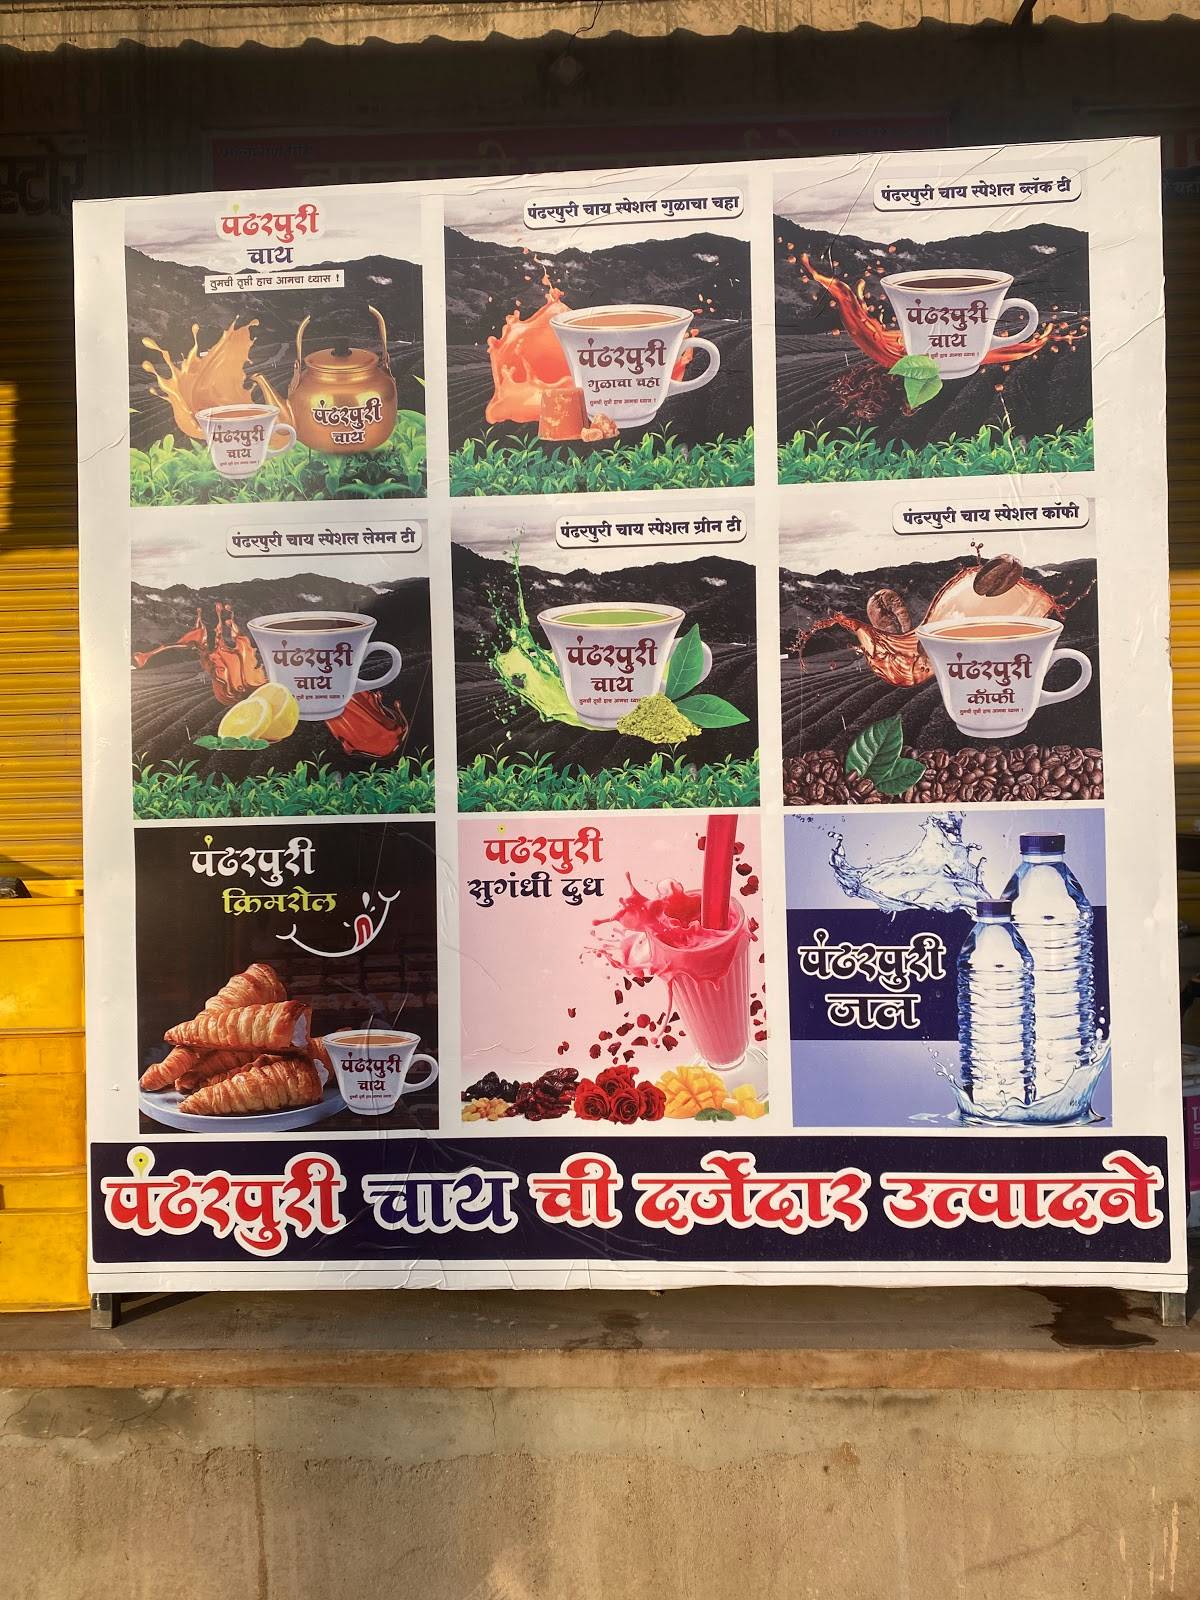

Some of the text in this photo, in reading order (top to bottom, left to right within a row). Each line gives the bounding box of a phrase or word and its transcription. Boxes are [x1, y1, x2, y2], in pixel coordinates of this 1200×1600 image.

[881, 176, 1072, 206] पंढरपुरी चाय स्पेशल ब्लॅक टी
[221, 203, 320, 243] पंढरपुरी
[527, 195, 740, 223] पंढरपुरी चाय स्पेशल गुळाचा चहा
[247, 246, 294, 265] चाय
[906, 298, 989, 330] पंढरपुरी
[928, 333, 968, 347] चाय
[577, 338, 667, 374] पंढरपुरी
[588, 378, 632, 393] गुळाचा
[312, 399, 383, 427] पंढरपुरी
[213, 424, 265, 446] पंढरपुरी
[332, 430, 365, 444] चाय
[226, 448, 252, 458] चाय
[560, 515, 742, 542] पंढरपुरी चाय स्पेशल ग्रीन टी
[903, 502, 1080, 529] पंढरपुरी चाय स्पेशल कॉफी
[231, 528, 416, 552] पंढरपुरी चाय स्पेशल लेमन टी
[272, 640, 353, 673] पंढरपुरी
[566, 635, 658, 673] पंढरपुरी
[294, 676, 333, 689] चाय
[947, 652, 1032, 687] पंढरपुरी
[591, 676, 634, 692] चाय
[966, 688, 1016, 705] कॉफी
[190, 835, 316, 887] पंढरपुरी
[483, 824, 604, 875] पंढरपुरी
[222, 886, 337, 915] क्रिमरोल
[467, 871, 605, 907] सुगंधी दुध
[798, 928, 946, 992] पंढरपुरी
[825, 994, 921, 1030] जल
[341, 1051, 402, 1078] पंढरपुरी
[357, 1080, 386, 1091] चाय
[102, 1146, 1163, 1255] पंढरपुरी चाय ची दर्जेदार उत्पादने
